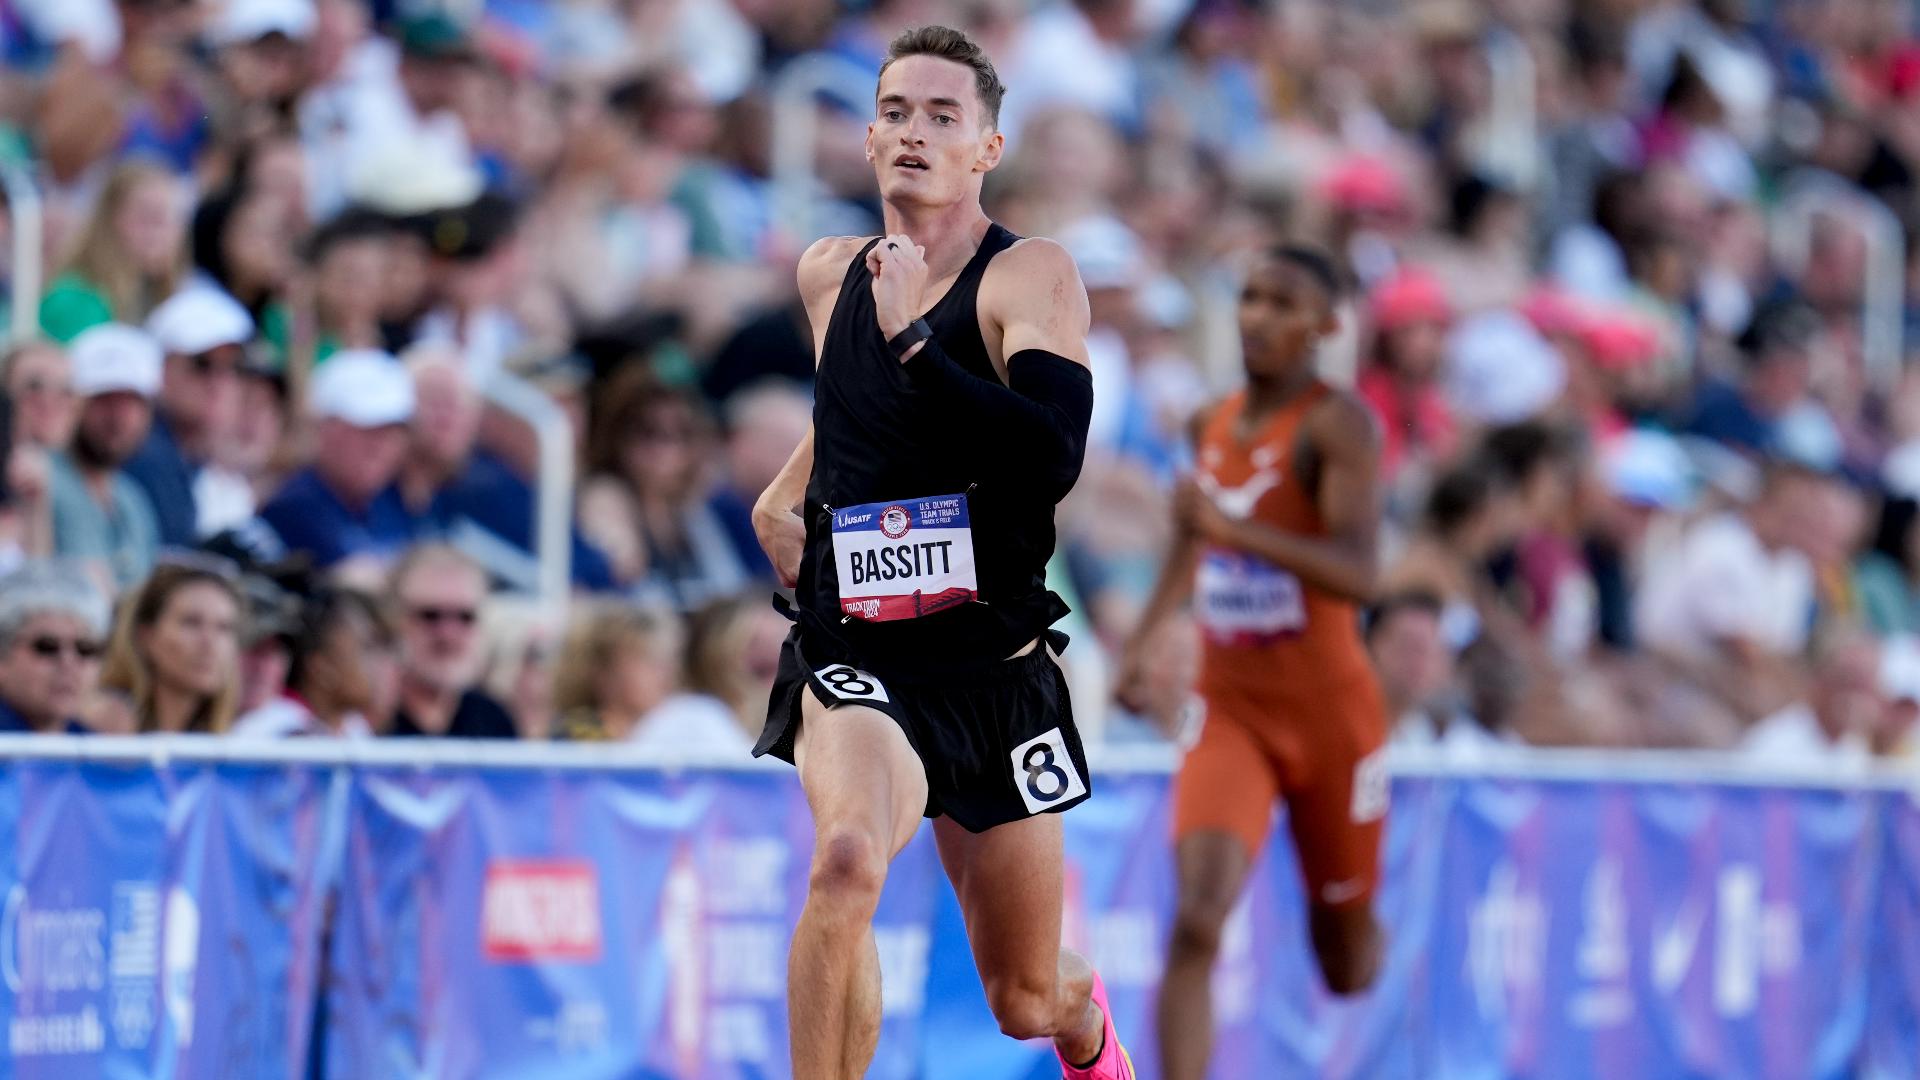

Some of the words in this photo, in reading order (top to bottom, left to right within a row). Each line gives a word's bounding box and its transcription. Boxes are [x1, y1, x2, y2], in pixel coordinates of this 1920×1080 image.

[933, 500, 959, 509] OLYMPIC
[848, 514, 871, 525] USATF
[920, 510, 937, 519] TEAM
[938, 508, 960, 517] TRIALS
[850, 541, 952, 585] BASSITT
[864, 607, 878, 619] 2024
[822, 667, 875, 696] 8
[1023, 743, 1069, 802] 8
